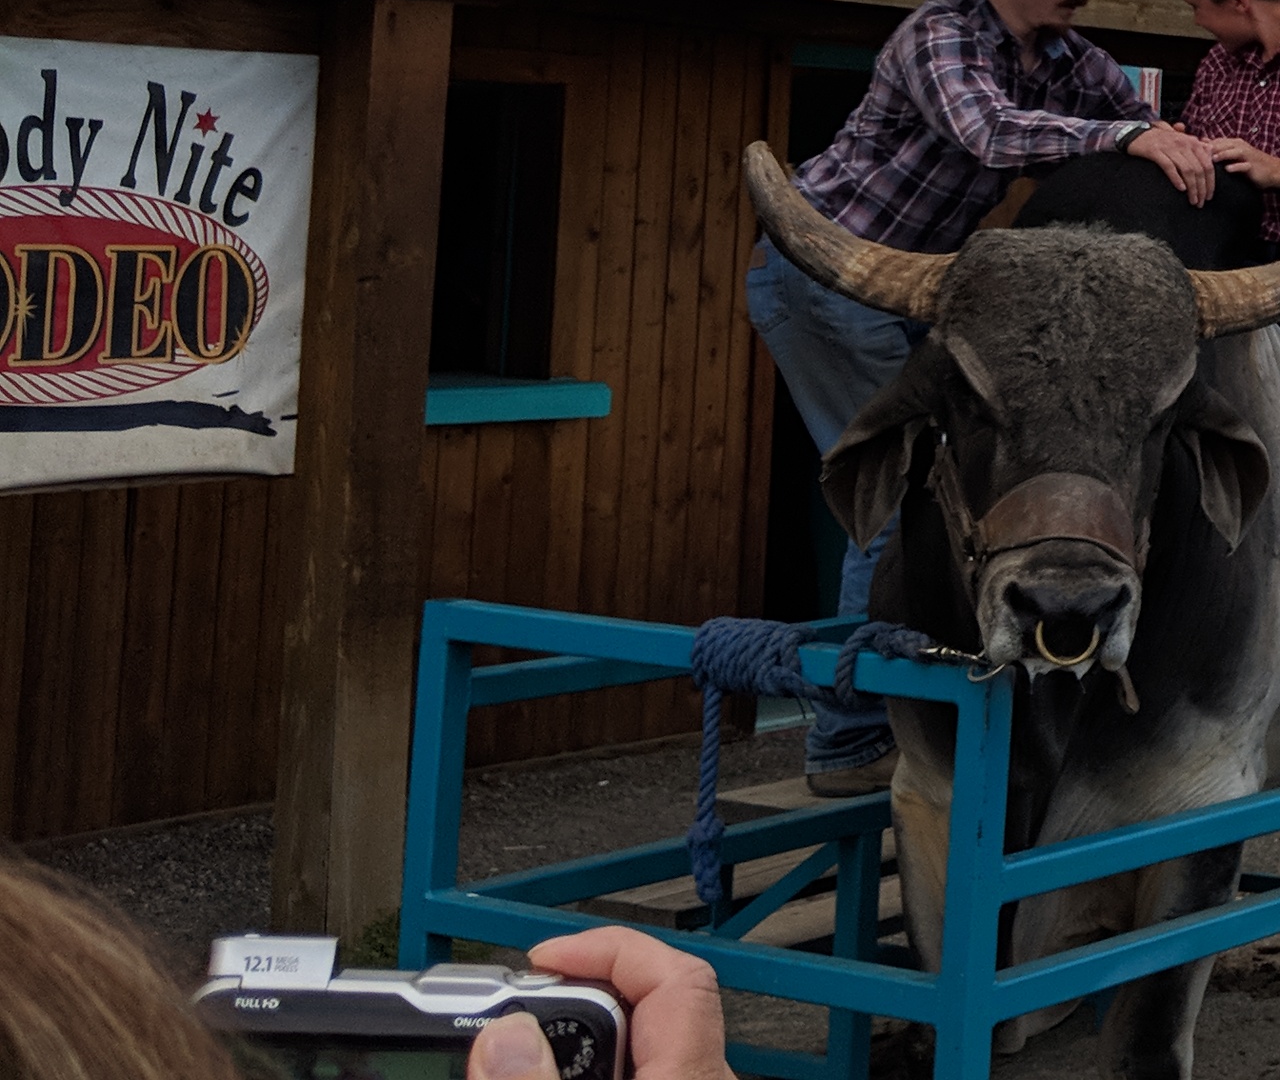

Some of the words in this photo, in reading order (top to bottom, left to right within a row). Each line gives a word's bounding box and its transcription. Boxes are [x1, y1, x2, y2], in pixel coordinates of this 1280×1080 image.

[121, 81, 263, 226] Nite
[244, 956, 274, 973] 12.1
[234, 997, 261, 1009] FULL
